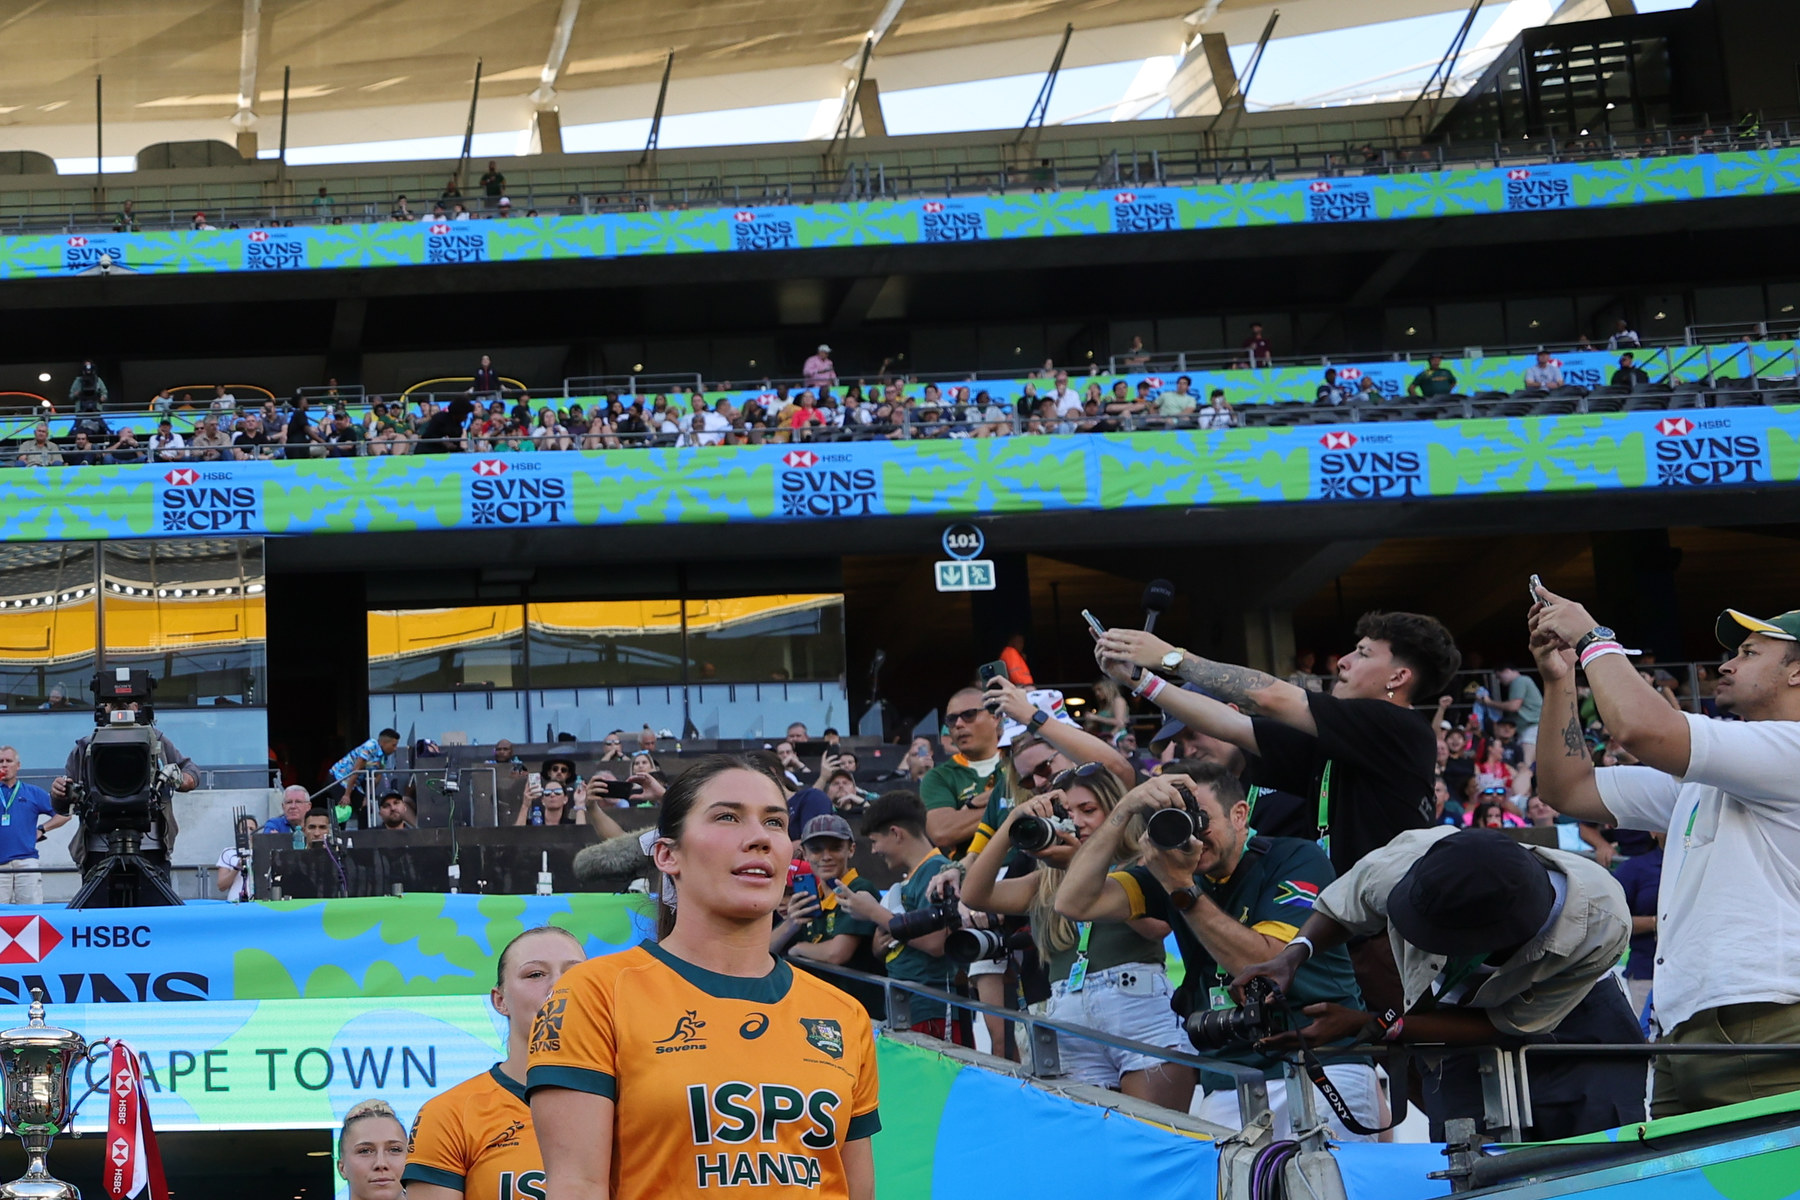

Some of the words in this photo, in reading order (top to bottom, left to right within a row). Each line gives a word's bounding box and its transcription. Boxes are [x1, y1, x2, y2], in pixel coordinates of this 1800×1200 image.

[1506, 179, 1568, 194] SVNS
[1309, 192, 1368, 207] SVNS
[1522, 193, 1570, 210] CPT
[1114, 203, 1173, 218] SVNS
[1325, 205, 1370, 221] CPT
[923, 213, 980, 227] SVNS
[1130, 217, 1175, 233] CPT
[735, 222, 791, 236] SVNS
[939, 226, 981, 241] CPT
[248, 243, 302, 256] SVNS
[429, 236, 483, 250] SVNS
[751, 234, 792, 250] CPT
[263, 255, 302, 270] CPT
[444, 248, 483, 263] CPT
[1698, 418, 1730, 428] HSBC
[1361, 434, 1391, 444] HSBC
[1656, 436, 1760, 461] SVNS
[511, 462, 540, 471] HSBC
[822, 454, 852, 463] HSBC
[1321, 451, 1419, 476] SVNS
[203, 471, 232, 480] HSBC
[1679, 458, 1762, 486] CPT
[782, 469, 876, 492] SVNS
[1343, 473, 1421, 498] CPT
[471, 478, 564, 500] SVNS
[162, 488, 255, 510] SVNS
[804, 492, 877, 516] CPT
[495, 500, 566, 524] CPT
[185, 509, 256, 532] CPT
[948, 534, 979, 548] 101
[72, 926, 151, 948] HSBC
[655, 1043, 708, 1054] Sevens
[255, 1047, 437, 1093] TOWN
[1322, 1083, 1351, 1121] SONY
[118, 1099, 127, 1125] HSBC
[686, 1081, 842, 1150] ISPS
[695, 1153, 823, 1190] HANDA
[113, 1169, 123, 1194] HSBC
